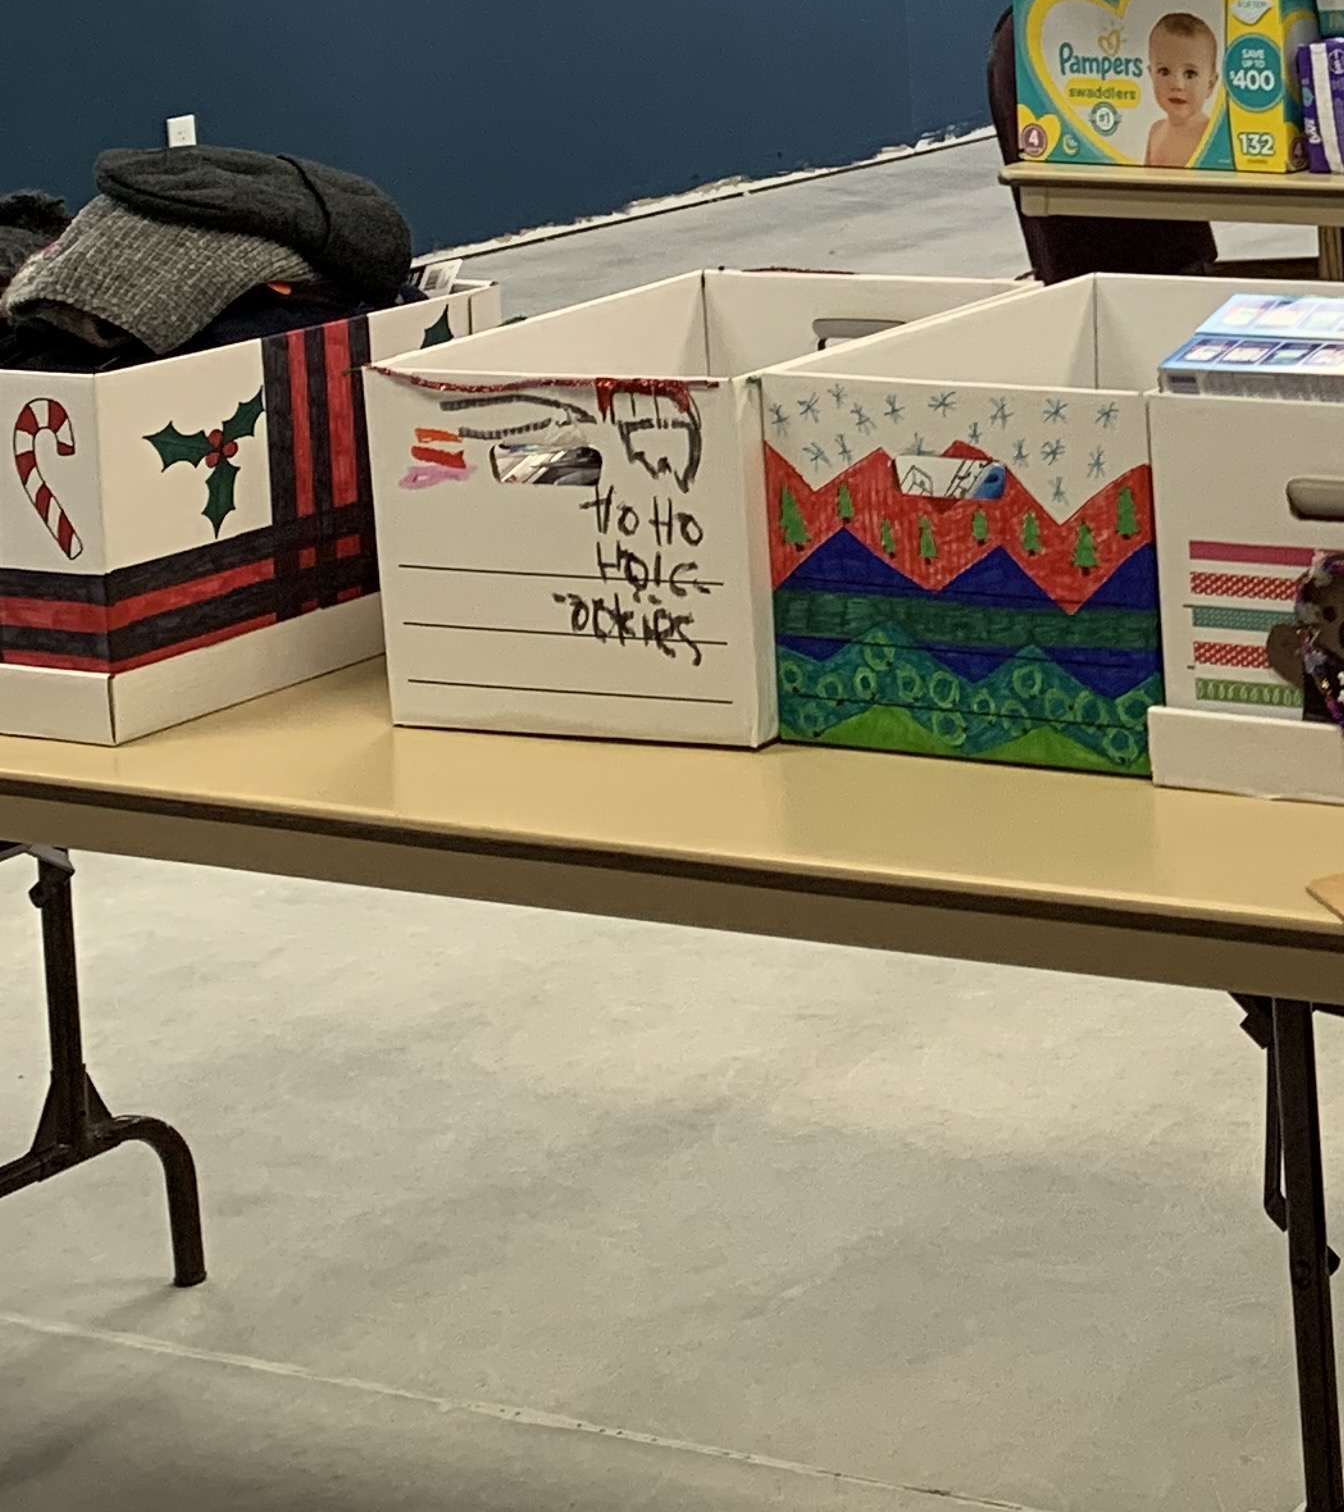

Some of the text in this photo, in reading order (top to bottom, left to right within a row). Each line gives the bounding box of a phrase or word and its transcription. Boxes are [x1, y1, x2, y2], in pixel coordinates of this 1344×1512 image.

[1058, 42, 1143, 80] Pampers
[1241, 49, 1265, 60] SAVE
[1228, 69, 1276, 92] $400
[1068, 85, 1137, 101] swaddlers
[1027, 129, 1040, 148] 4
[1237, 131, 1276, 157] 132
